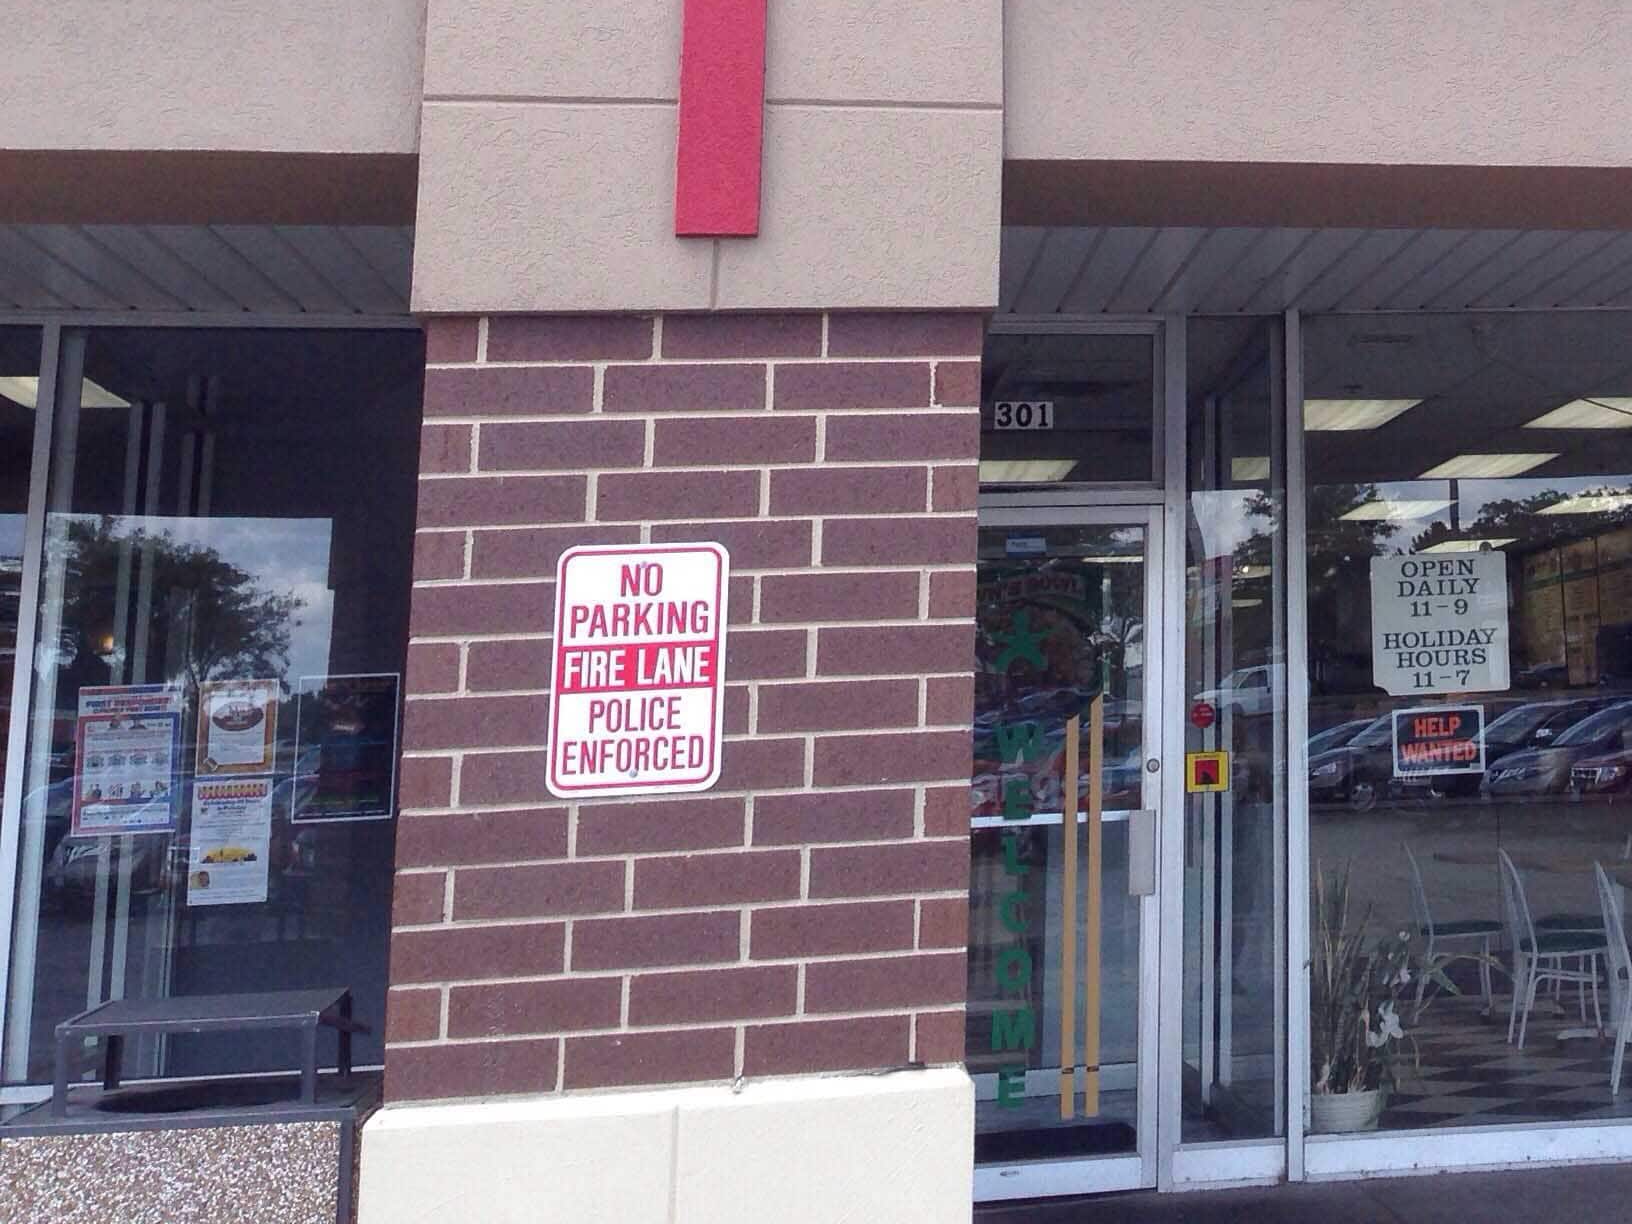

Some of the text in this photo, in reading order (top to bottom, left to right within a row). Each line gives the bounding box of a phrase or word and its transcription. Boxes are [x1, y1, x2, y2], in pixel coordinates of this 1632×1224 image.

[996, 403, 1049, 427] 301
[620, 562, 664, 598] NO
[1400, 558, 1475, 579] OPEN
[1397, 578, 1480, 598] DAILY
[569, 600, 710, 639] PARKING
[1383, 628, 1498, 650] HOLIDAY
[563, 646, 710, 689] FIRE LANE
[1396, 647, 1487, 669] HOURS
[588, 696, 682, 734] POLICE
[1413, 715, 1462, 738] HELP
[561, 735, 705, 776] ENFORCED
[1400, 738, 1478, 763] WANTED
[990, 720, 1043, 1112] WELCOME
